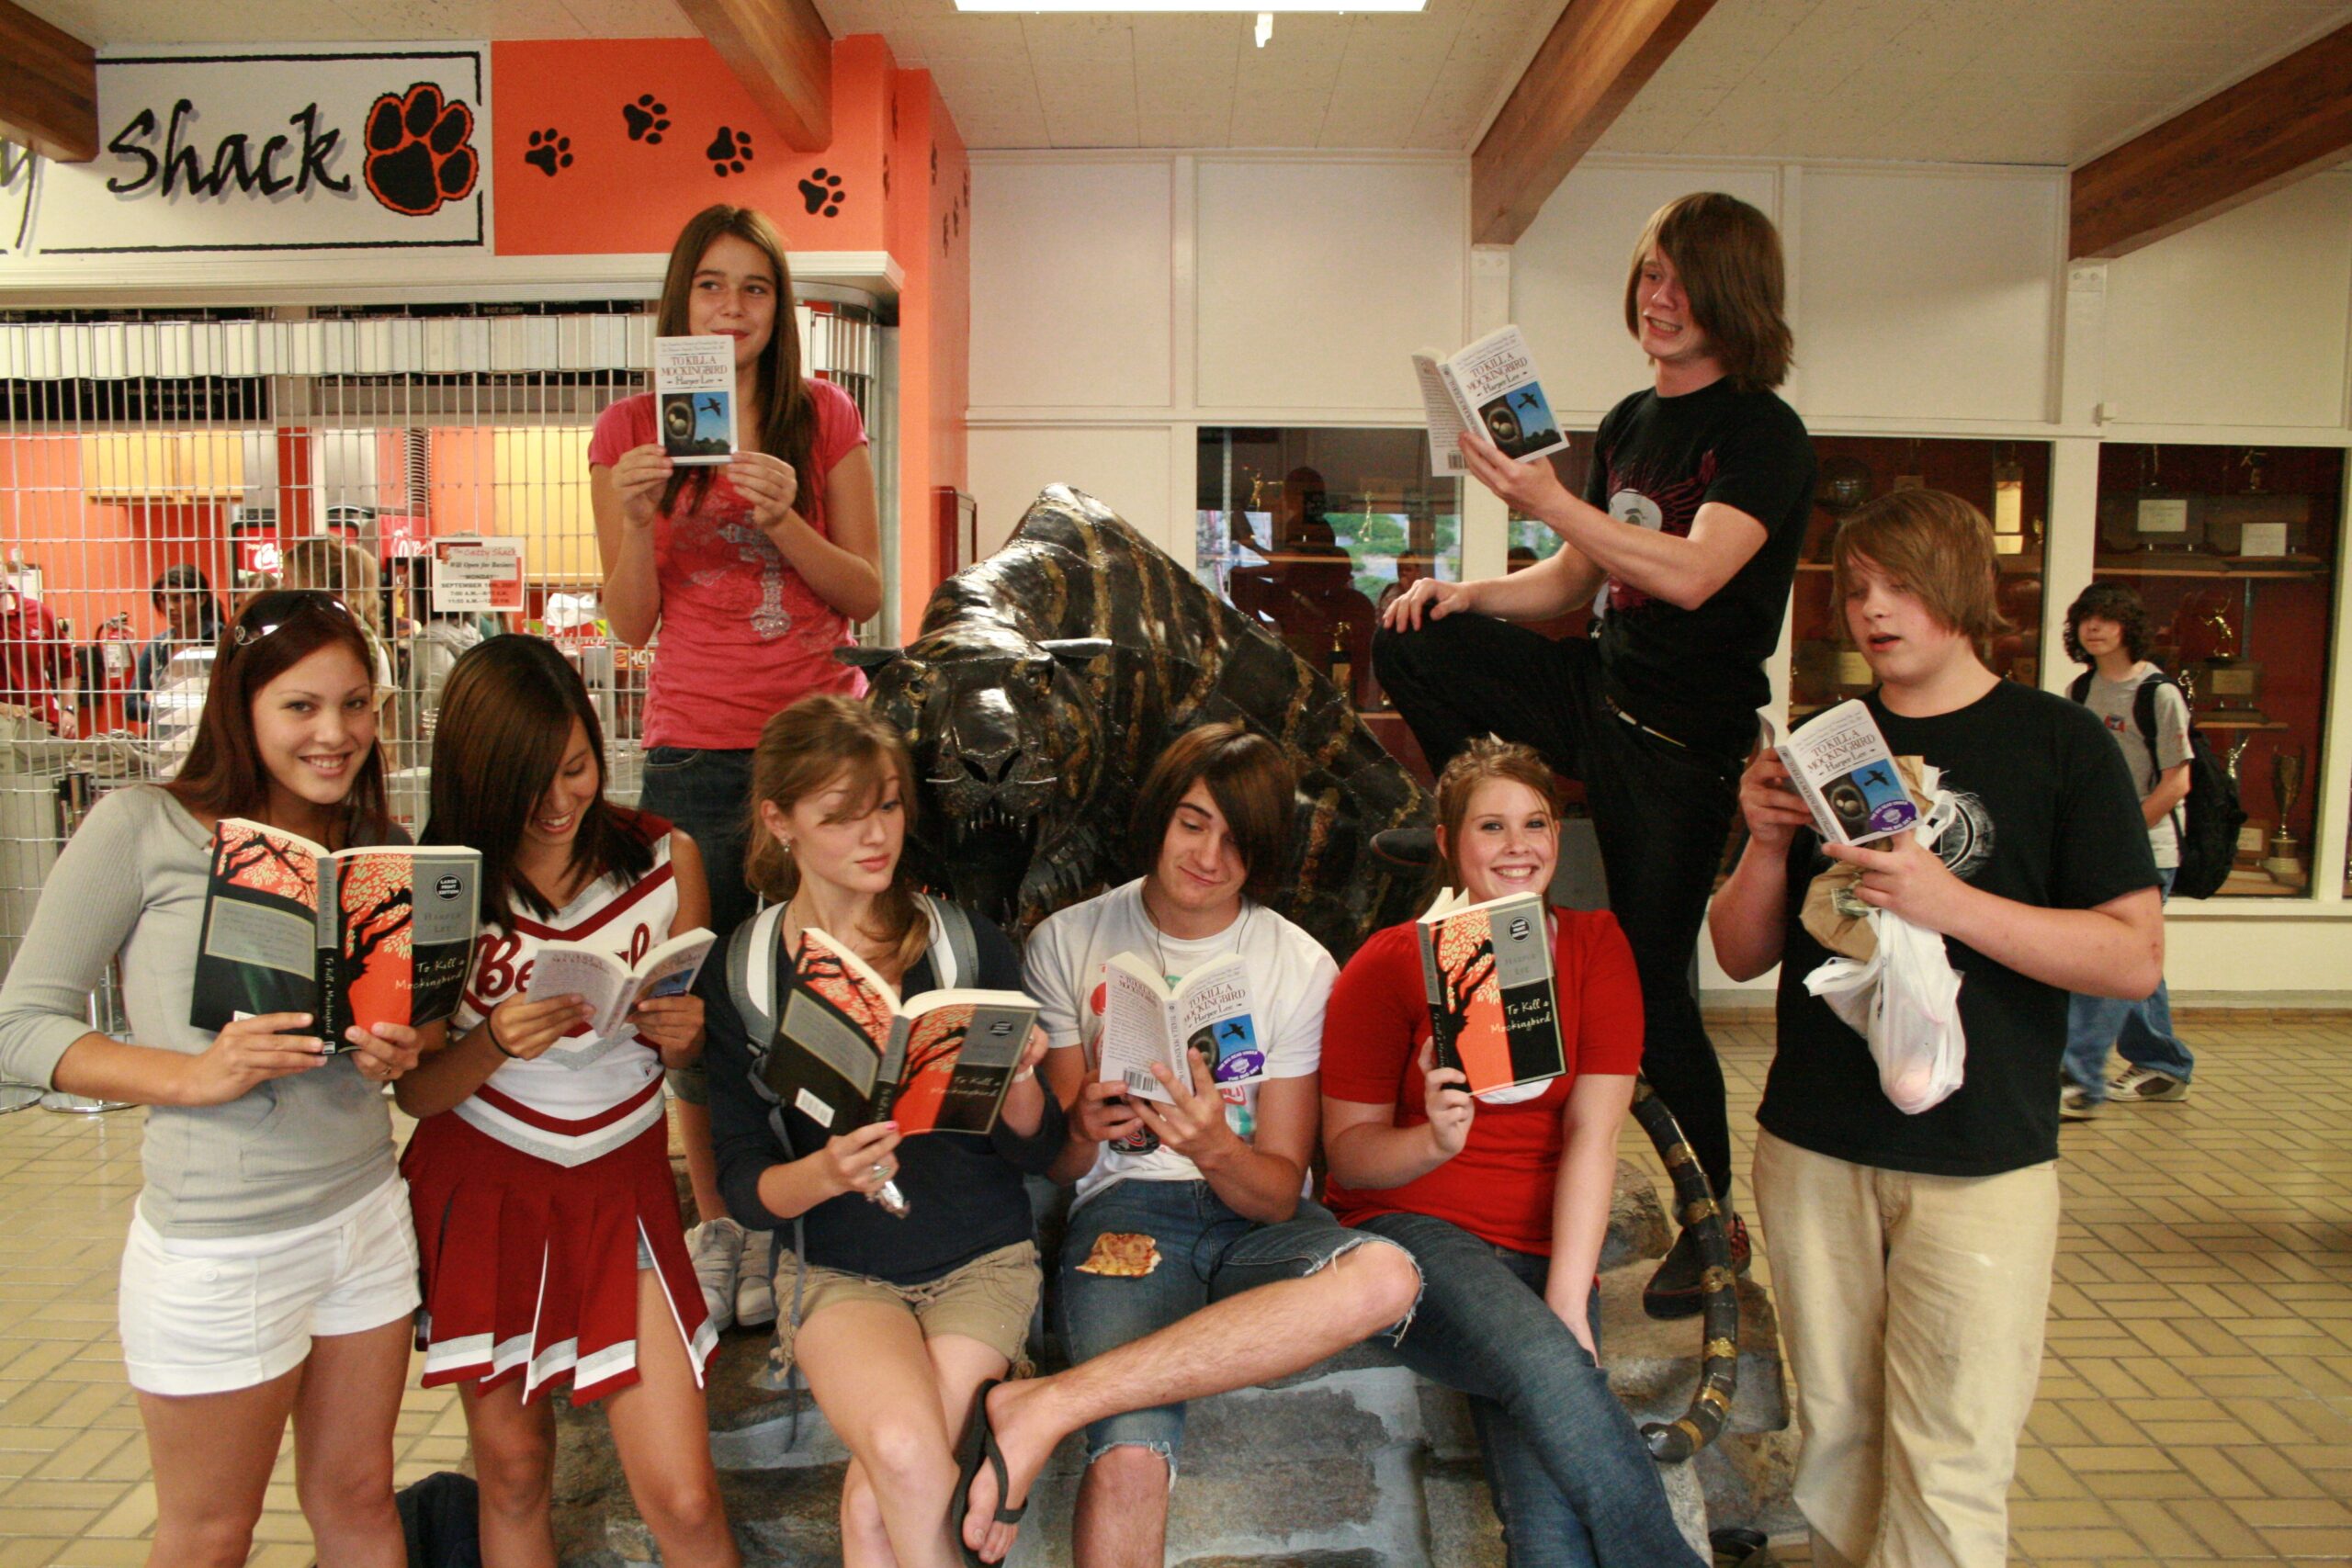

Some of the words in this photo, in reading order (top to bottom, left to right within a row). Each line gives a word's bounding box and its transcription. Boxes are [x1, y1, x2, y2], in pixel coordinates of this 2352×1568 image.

[107, 98, 350, 197] Shack
[662, 365, 728, 377] MOCKINGBIRD
[672, 356, 685, 366] TO
[685, 355, 708, 366] KILL
[710, 355, 717, 364] A
[1470, 366, 1485, 378] TO
[1481, 355, 1508, 373] KILL
[1507, 351, 1514, 362] A
[675, 375, 699, 386] Harper
[701, 374, 715, 384] Lee
[1466, 356, 1528, 391] MOCKINGBIRD
[1483, 378, 1507, 394] Harper
[1506, 373, 1521, 384] Lee
[1807, 734, 1875, 772] MOCKINGBIRD
[1810, 747, 1826, 757] TO
[1826, 734, 1852, 750] KILL
[1852, 729, 1860, 740] A
[1825, 756, 1852, 773] Harper
[1852, 749, 1867, 761] Lee
[424, 912, 462, 921] HARPER
[434, 925, 451, 933] LEE
[324, 957, 334, 967] To
[416, 963, 431, 973] To
[435, 957, 457, 971] Kill
[324, 968, 334, 982] Kill
[396, 969, 463, 991] Mockingbird
[1183, 988, 1246, 1022] MOCKINGBIRD
[1189, 997, 1201, 1009] TO
[1199, 986, 1224, 1003] KILL
[1225, 983, 1233, 992] A
[324, 989, 334, 1035] Mockingbird
[1193, 1010, 1217, 1024] Harper
[1218, 1004, 1233, 1013] Lee
[1506, 1005, 1519, 1016] To
[1521, 998, 1541, 1012] Kill
[1490, 1011, 1552, 1034] Mockingbird
